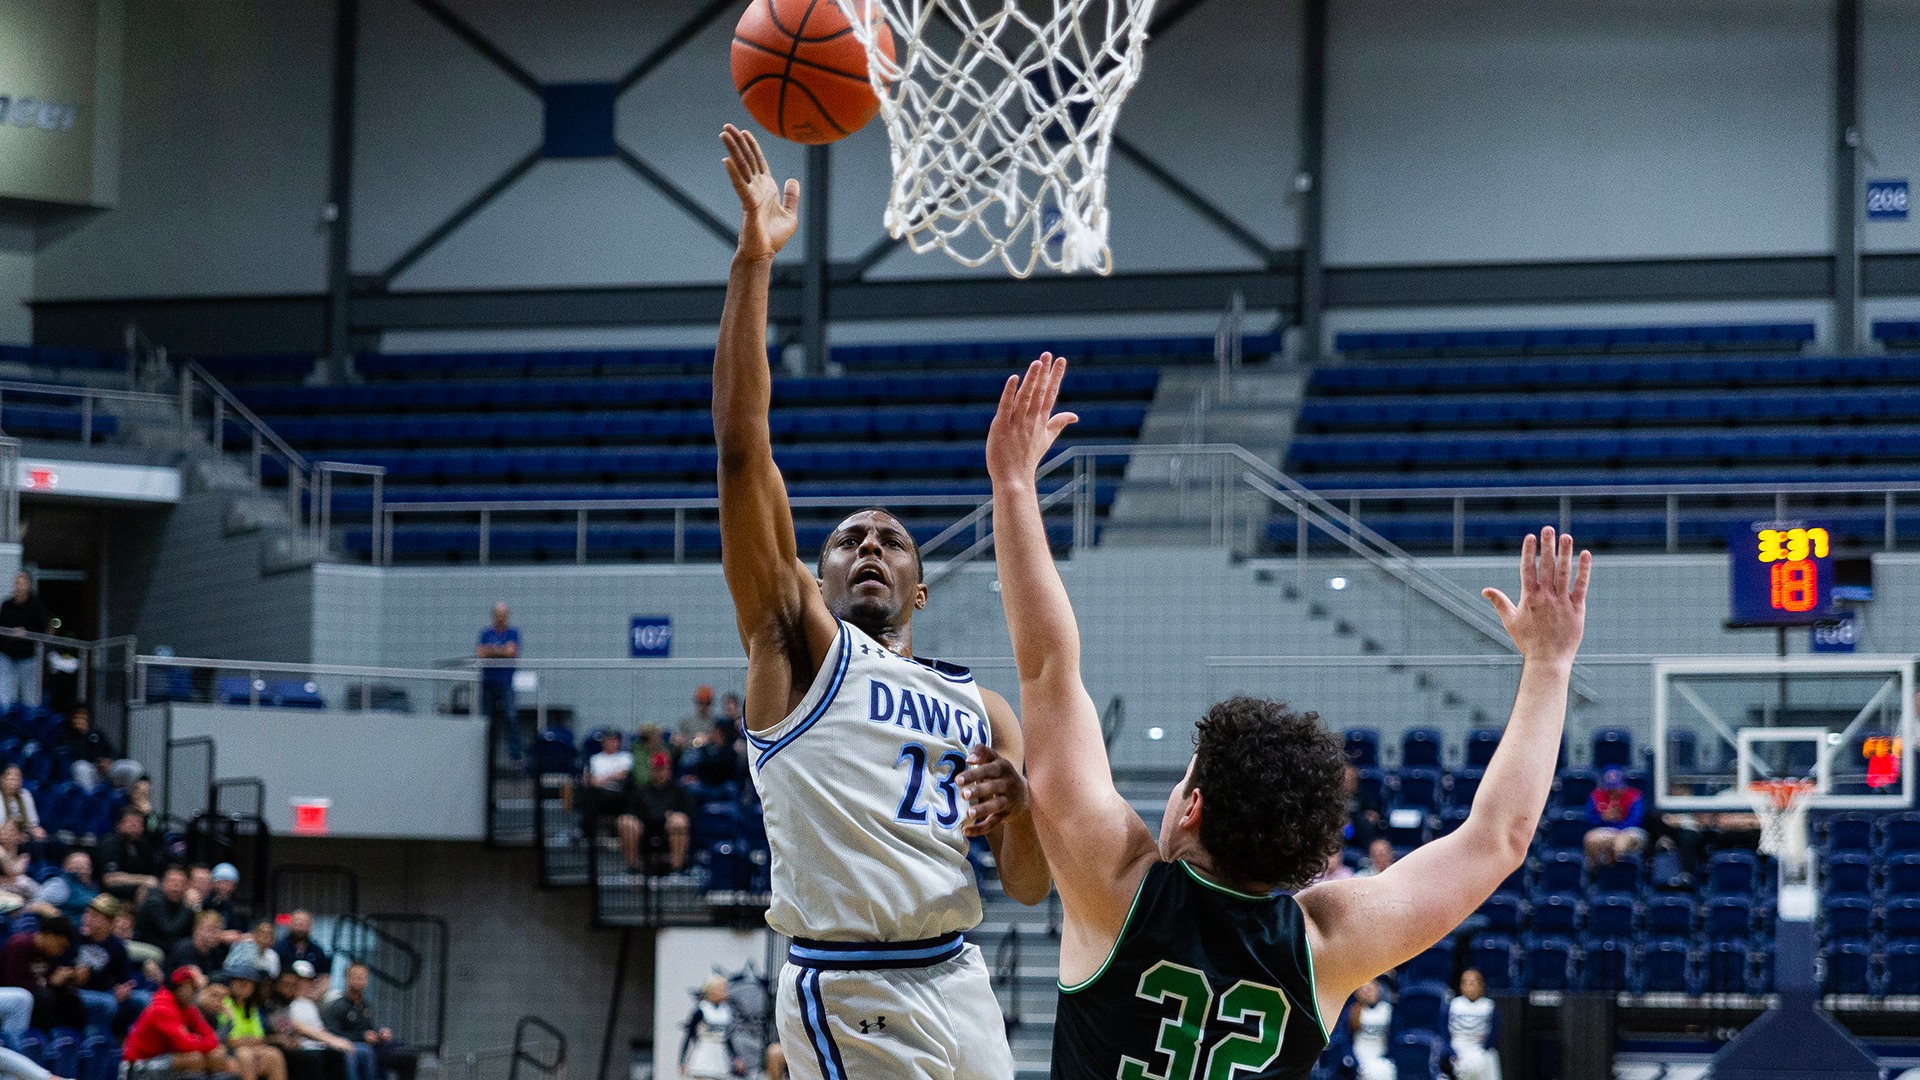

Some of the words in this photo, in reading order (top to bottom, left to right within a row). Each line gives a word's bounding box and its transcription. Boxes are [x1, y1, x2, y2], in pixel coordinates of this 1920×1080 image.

[1770, 559, 1817, 612] 18
[634, 625, 671, 649] 107
[894, 742, 968, 829] 23
[1116, 959, 1291, 1080] 32
